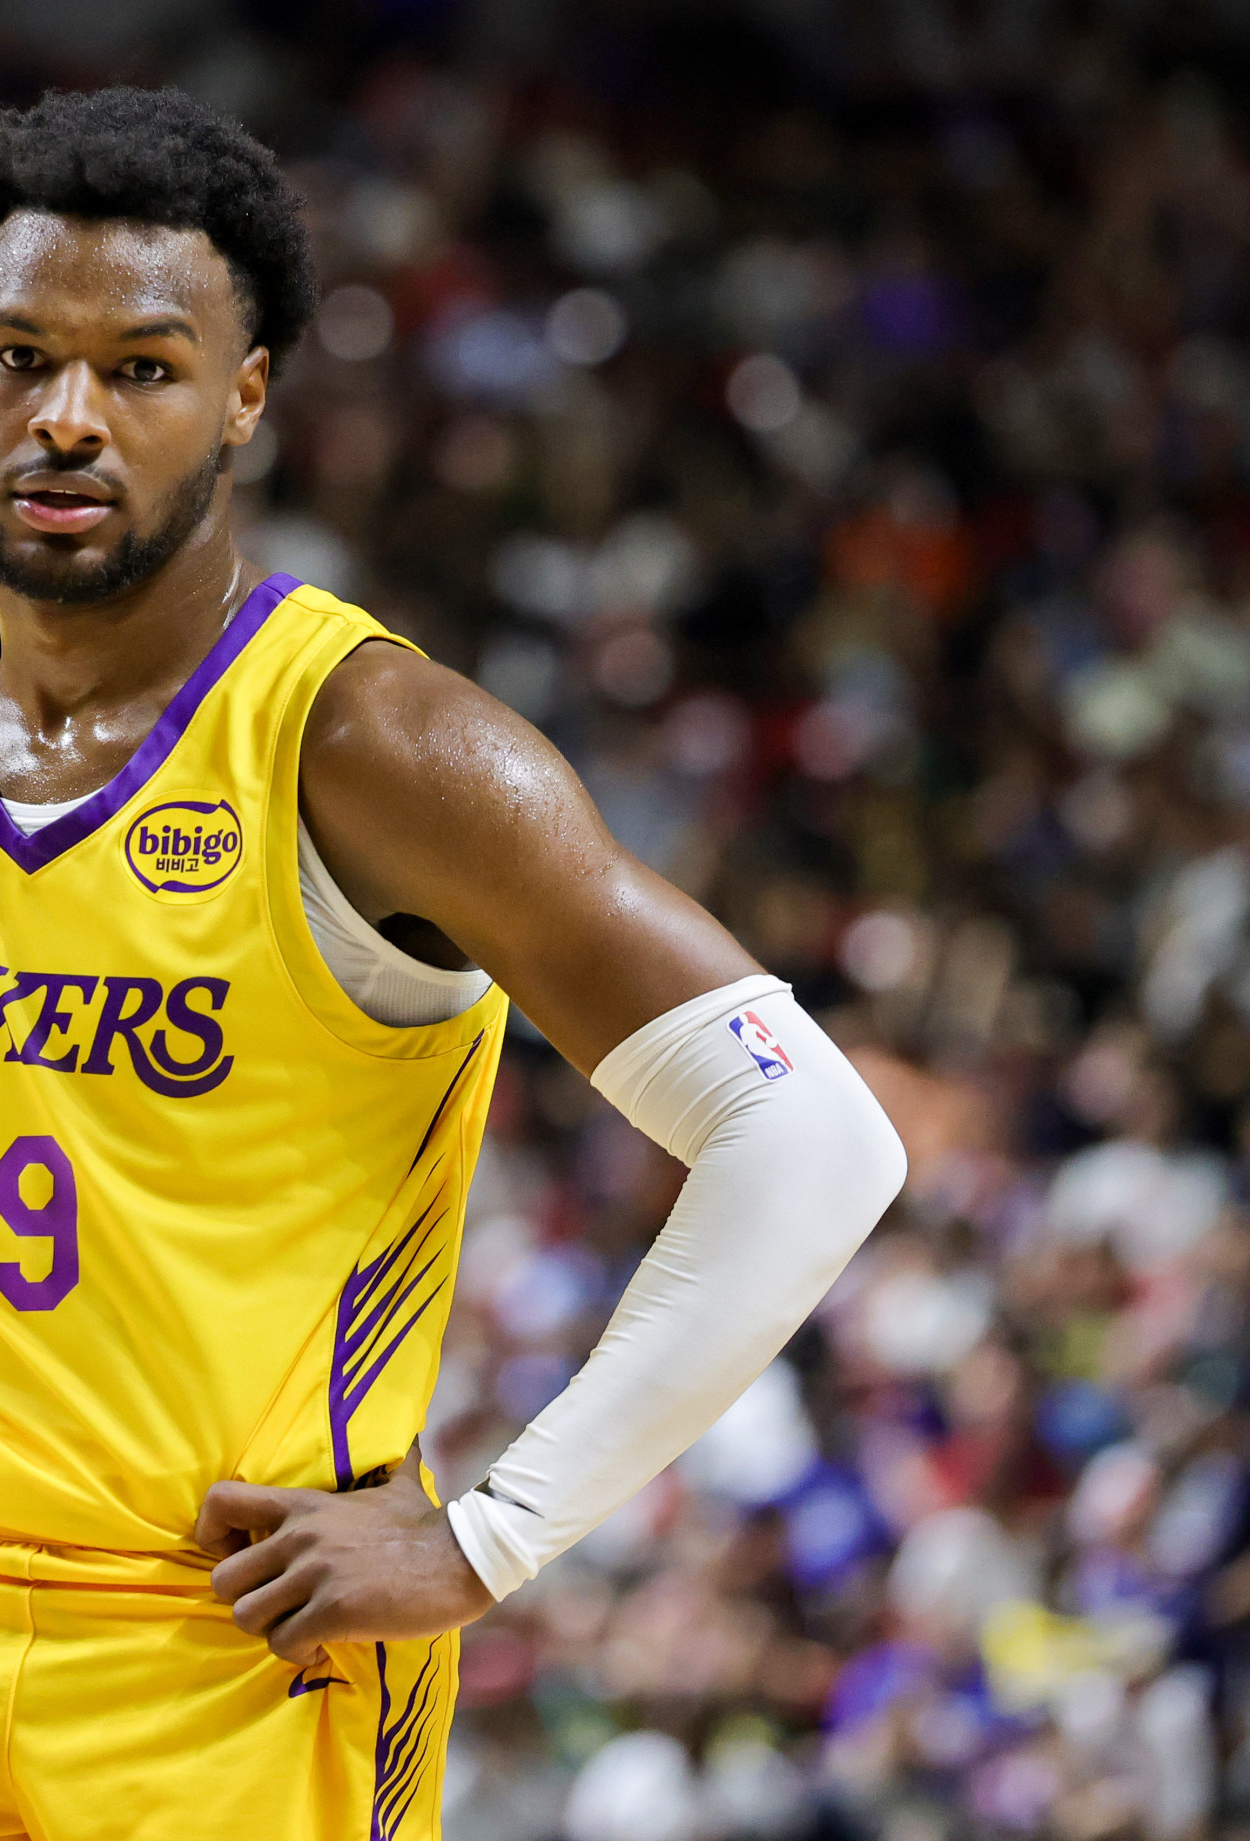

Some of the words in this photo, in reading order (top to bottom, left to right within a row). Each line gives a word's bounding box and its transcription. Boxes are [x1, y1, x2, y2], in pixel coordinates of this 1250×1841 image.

[138, 825, 238, 865] bibigo
[156, 858, 200, 873] 비비고
[765, 1062, 784, 1078] NBA
